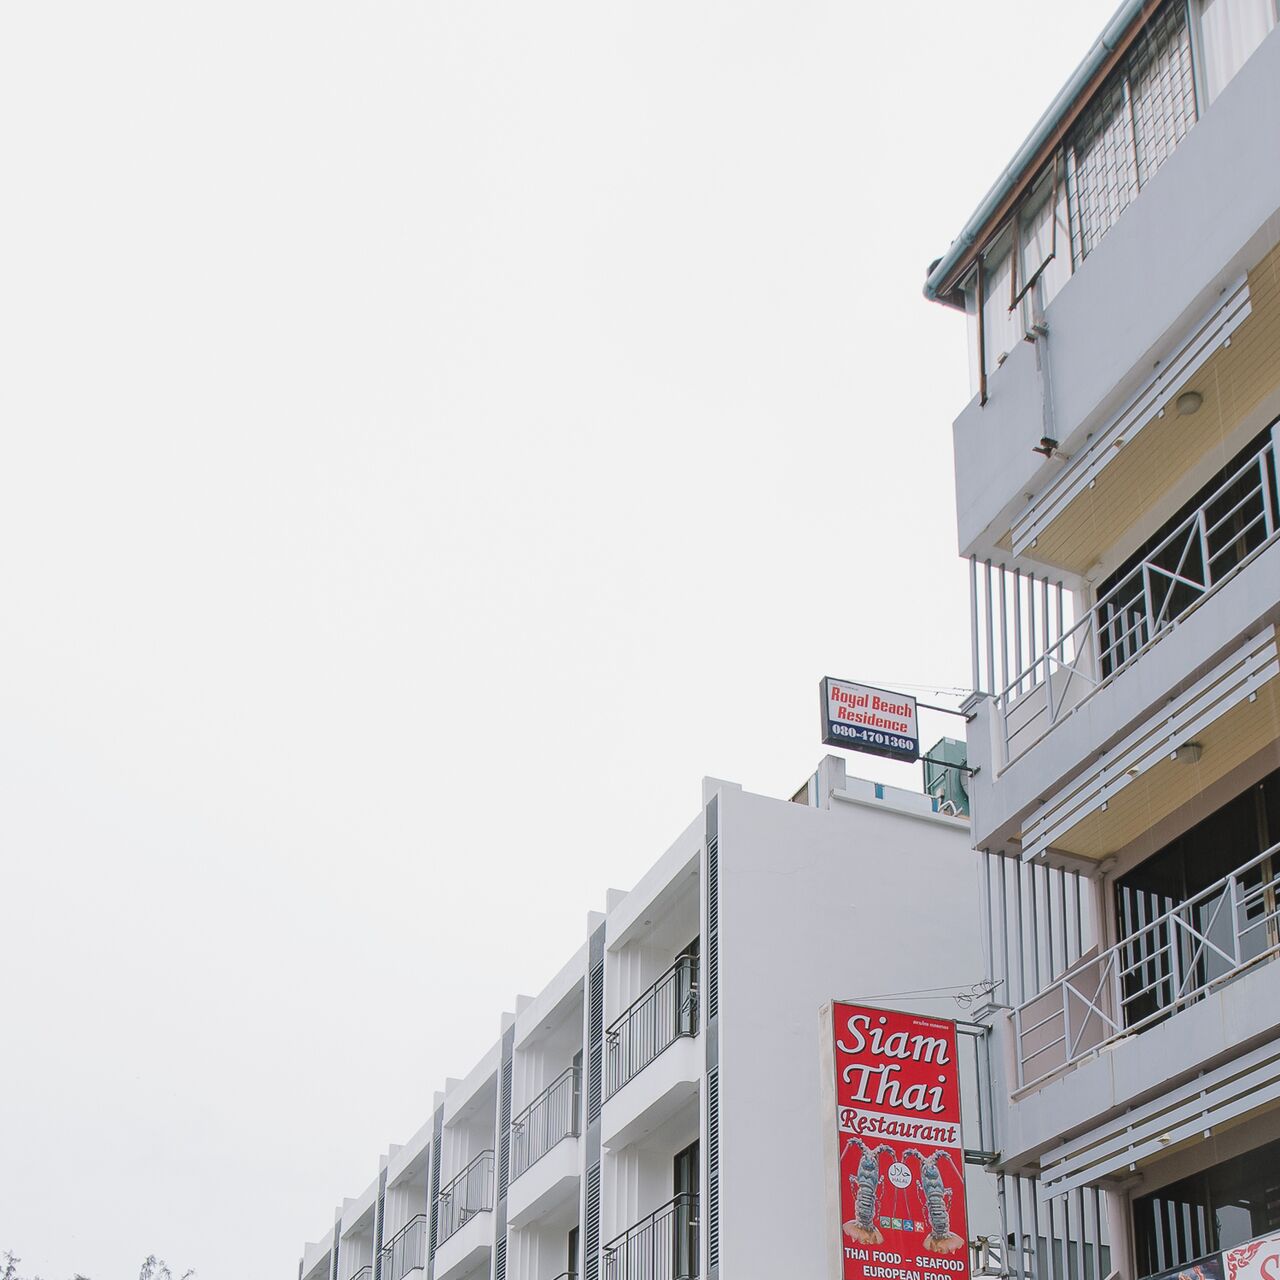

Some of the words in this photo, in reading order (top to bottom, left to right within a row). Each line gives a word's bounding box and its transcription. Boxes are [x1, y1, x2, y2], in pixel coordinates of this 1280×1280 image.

[831, 686, 869, 709] Royal
[872, 696, 912, 718] Beach
[837, 706, 908, 733] Residence
[832, 724, 914, 750] 080-4701360
[837, 1014, 950, 1065] Siam
[842, 1063, 946, 1114] Thai
[840, 1109, 957, 1143] Restaurant
[844, 1247, 869, 1261] THAI
[873, 1251, 901, 1265] FOOD
[916, 1256, 965, 1272] SEAFOOD
